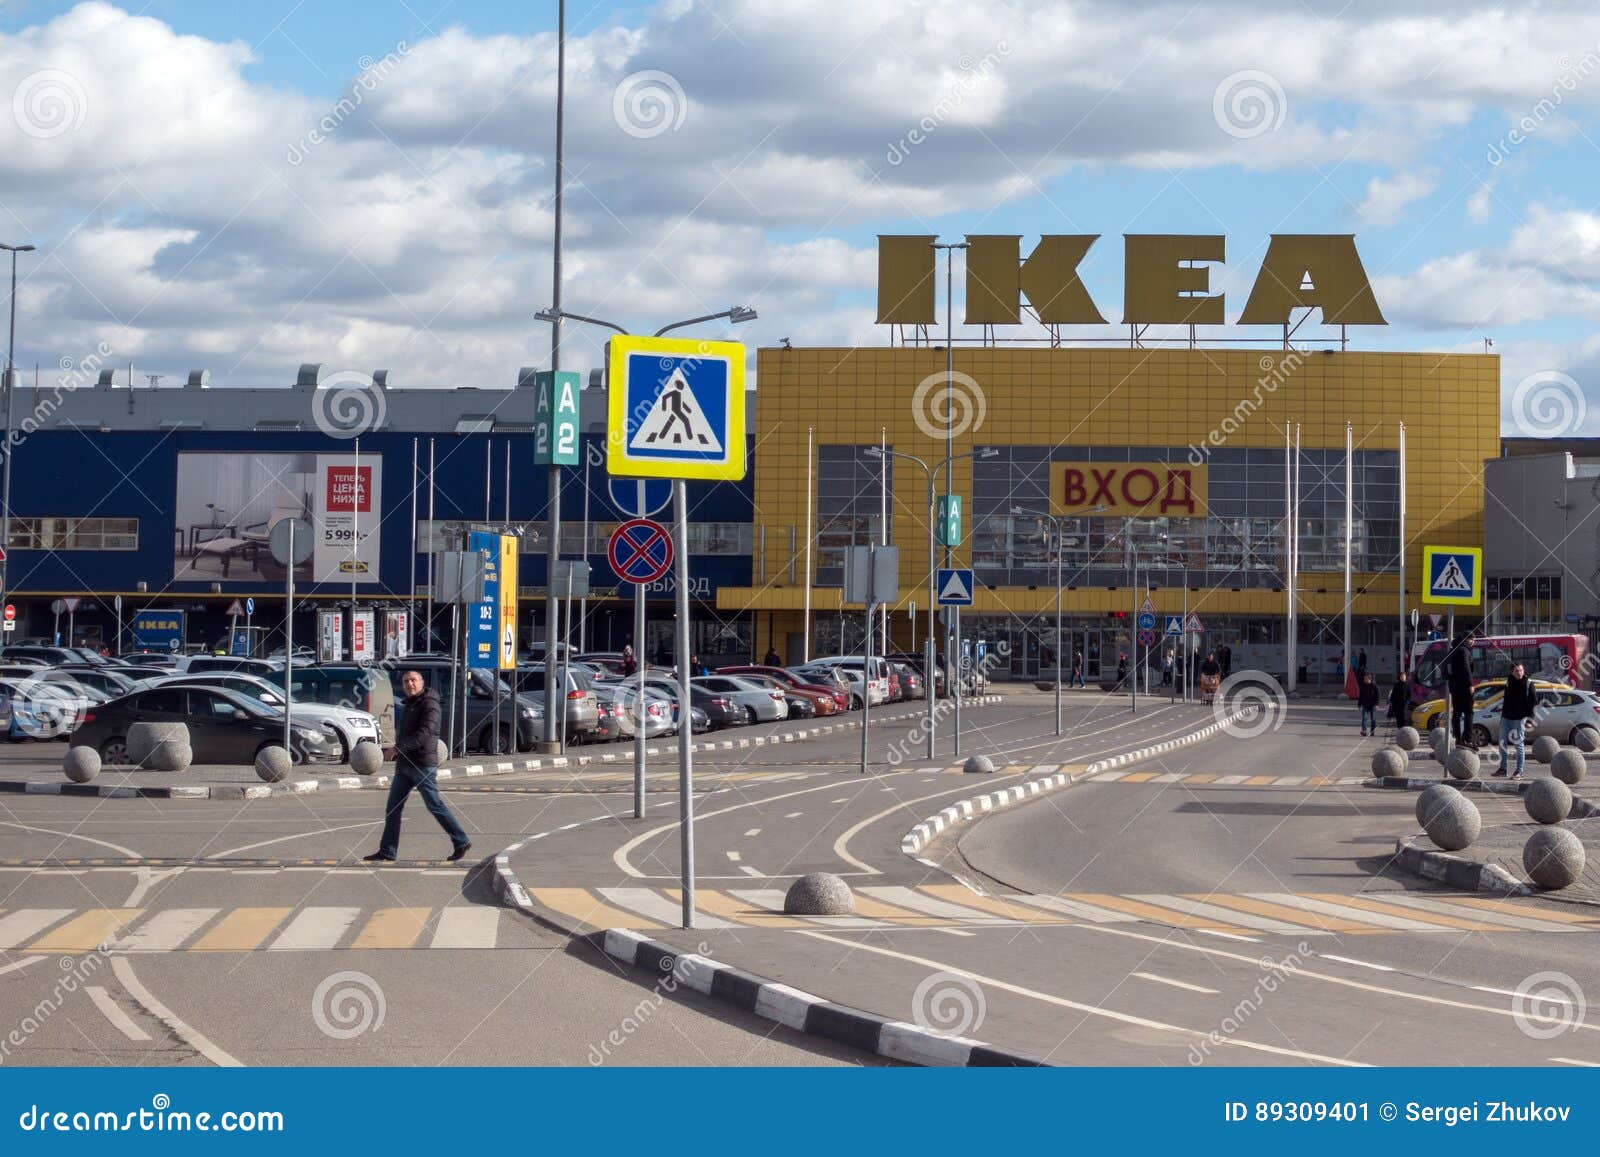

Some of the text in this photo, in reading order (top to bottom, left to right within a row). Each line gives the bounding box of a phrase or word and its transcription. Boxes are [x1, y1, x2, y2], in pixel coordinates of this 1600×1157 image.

[875, 235, 1388, 325] IKEA
[537, 381, 549, 413] A
[558, 381, 576, 413] A
[537, 422, 548, 454] 2
[558, 422, 575, 454] 2
[332, 483, 365, 494] ЦЕНА
[332, 495, 366, 503] НИЖЕ
[1064, 468, 1195, 514] ВХОД
[949, 500, 959, 518] A
[325, 529, 333, 540] 5
[950, 522, 957, 540] 1
[138, 620, 179, 630] IKEA
